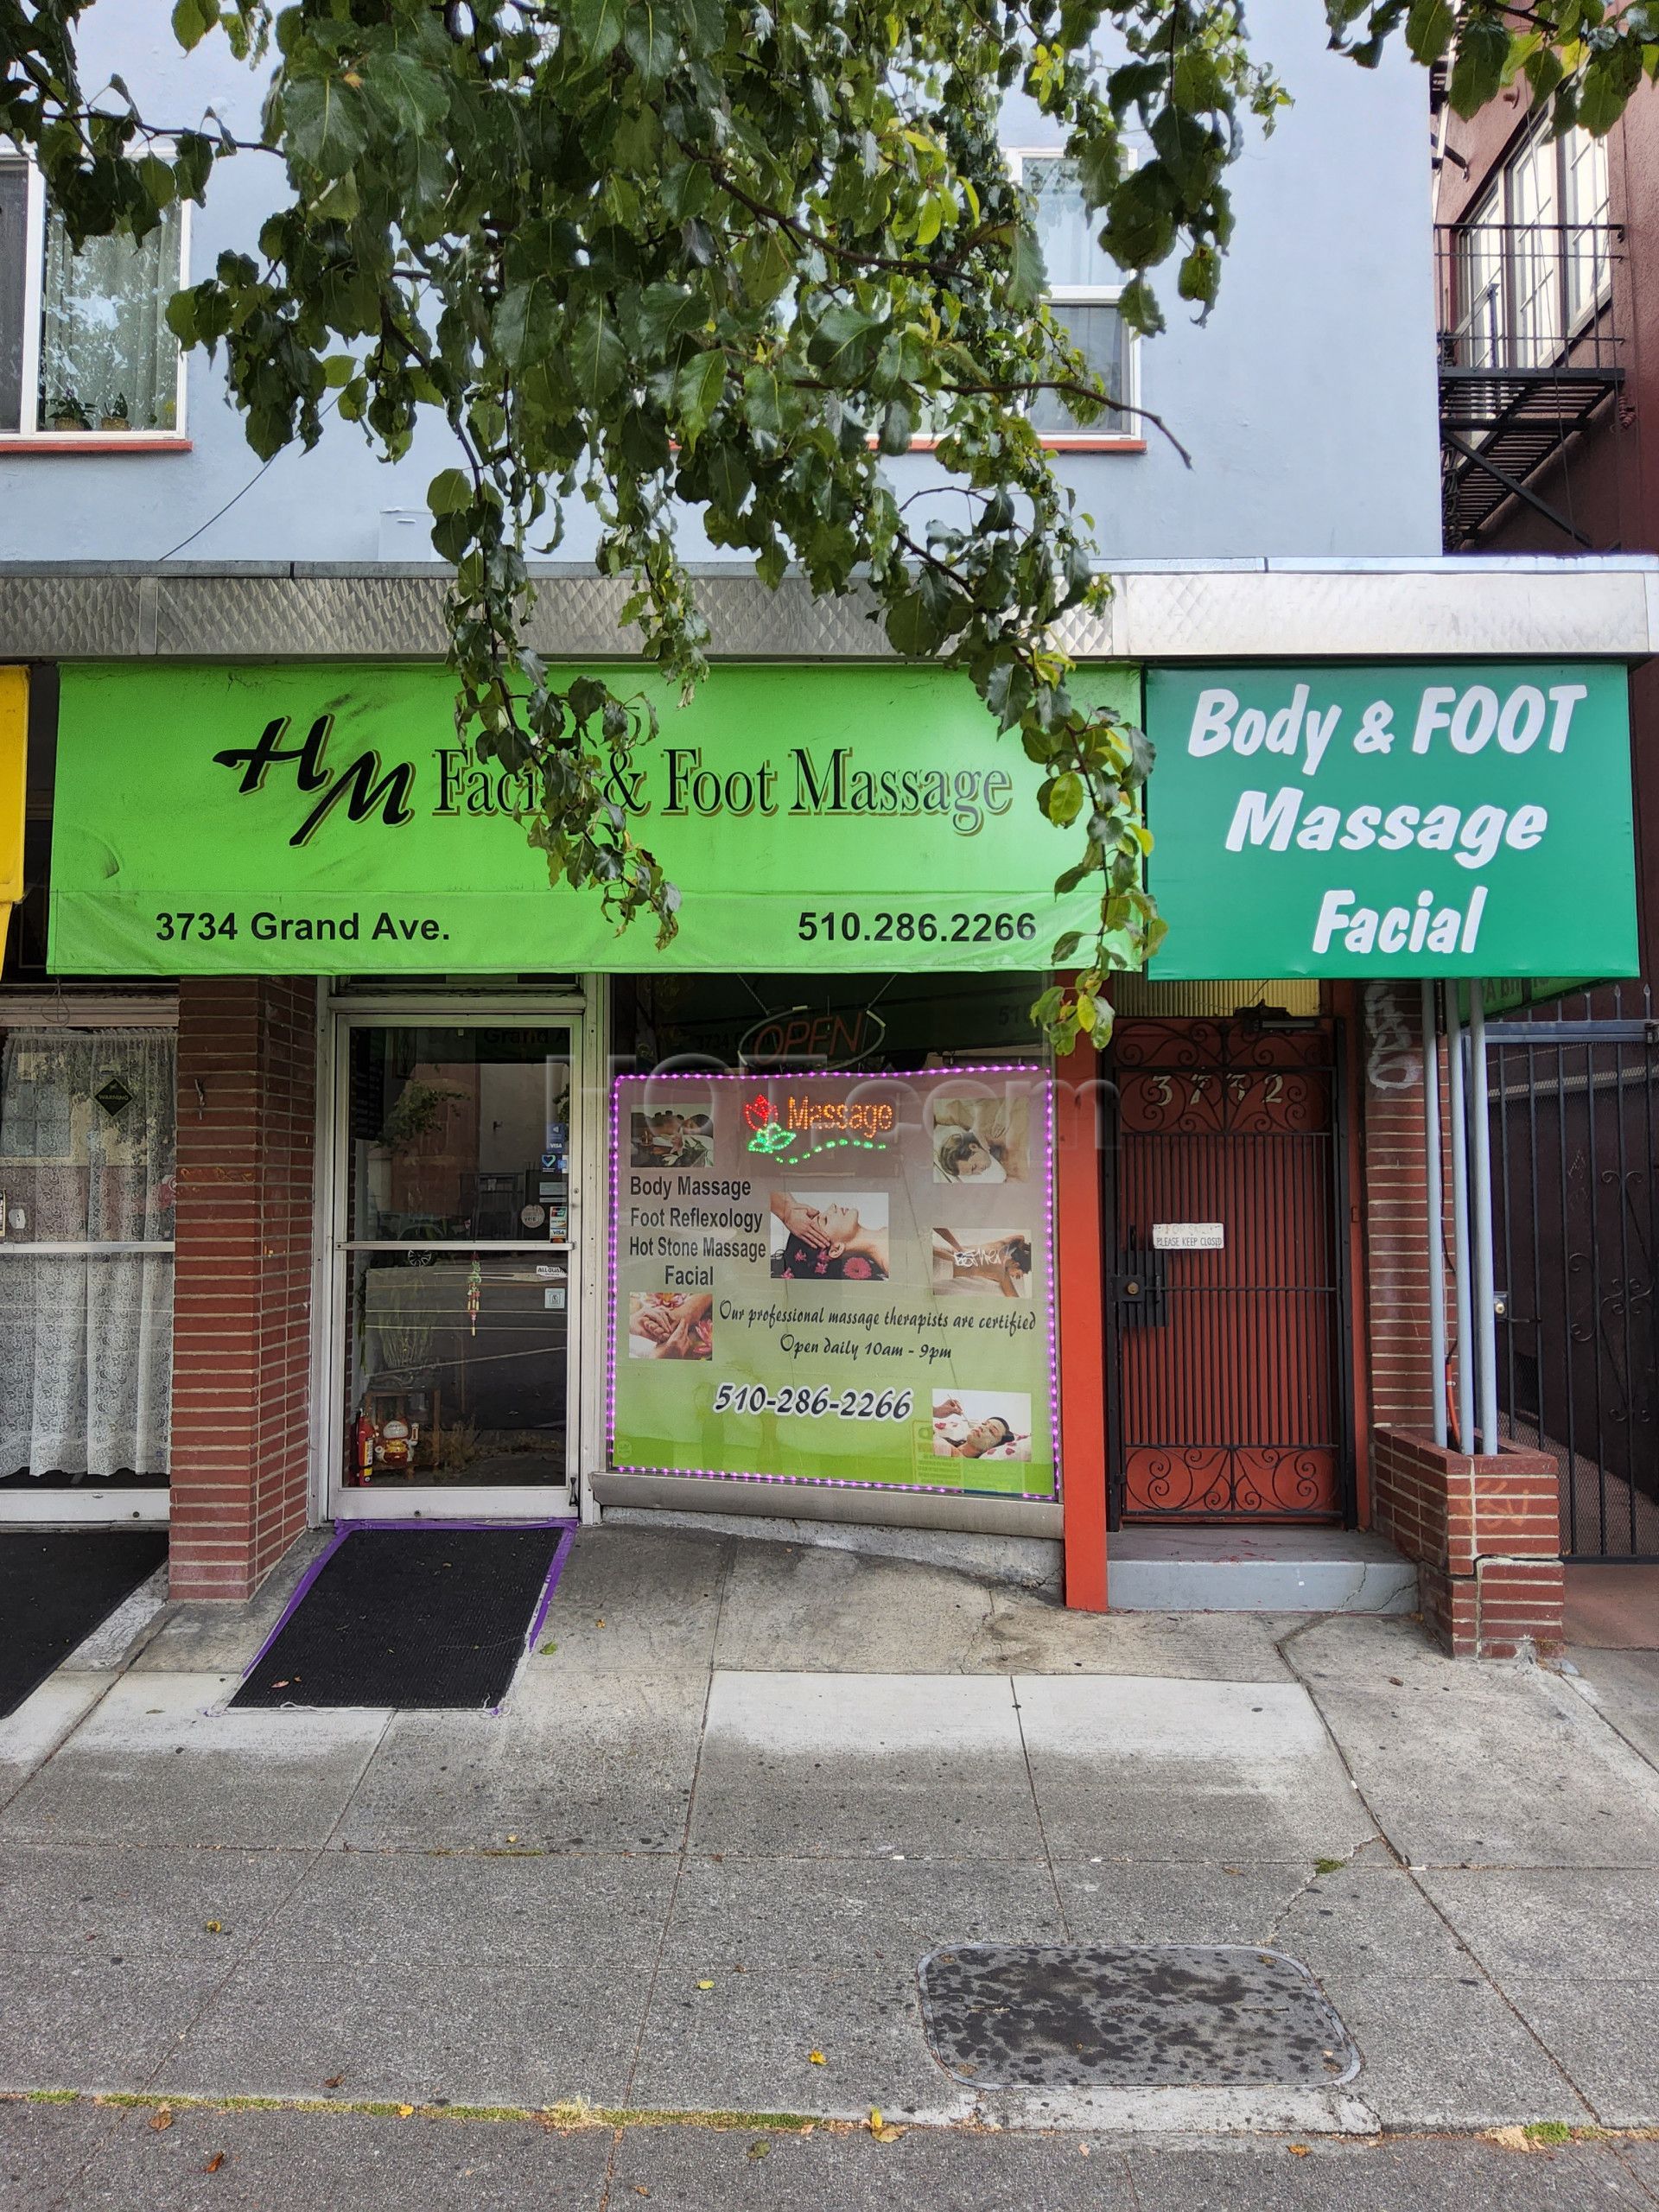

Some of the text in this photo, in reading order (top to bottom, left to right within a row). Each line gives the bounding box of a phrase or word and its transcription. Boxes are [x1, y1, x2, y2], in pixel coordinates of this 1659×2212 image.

[1188, 683, 1587, 776] Body & FOOT
[603, 750, 652, 817] &
[661, 747, 779, 817] Foot
[787, 747, 1012, 837] Massage
[1225, 786, 1548, 870] Massage
[156, 912, 449, 941] 3734 Grand Ave.
[798, 912, 1036, 942] 510.286.2266
[1313, 886, 1488, 954] Facial
[753, 1011, 863, 1065] OPEN
[788, 1095, 893, 1139] Massage
[631, 1176, 751, 1201] Body Massage
[631, 1207, 763, 1233] Foot Reflexology
[630, 1236, 766, 1263] Hot Stone Massage
[1156, 1237, 1222, 1248] PLEASE KEEP CLOSED
[664, 1265, 714, 1286] Facial
[720, 1300, 1036, 1338] Our professional massage therapists are certified
[780, 1333, 819, 1359] Open
[823, 1336, 858, 1361] daily
[864, 1341, 903, 1357] 10am
[918, 1343, 951, 1364] 9pm
[713, 1382, 913, 1423] 510-286-2266
